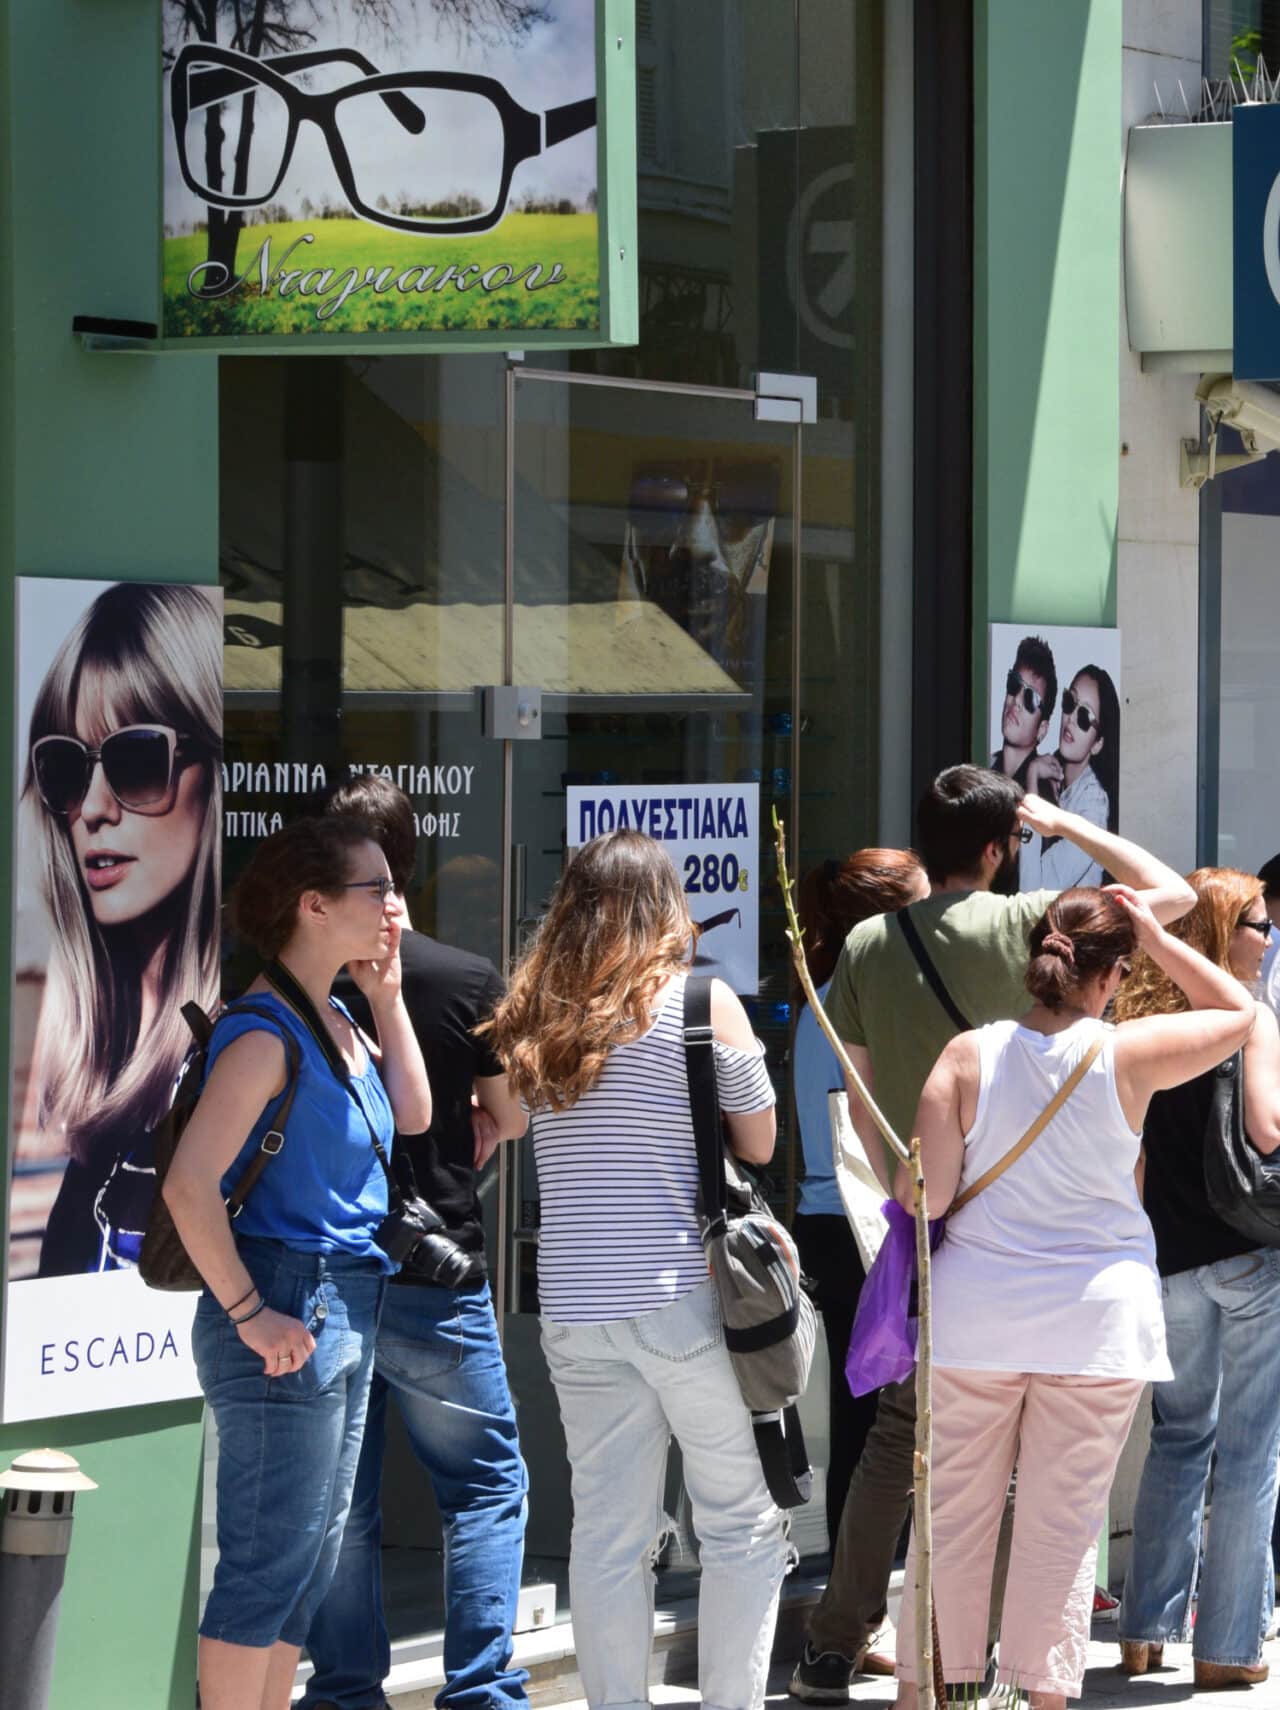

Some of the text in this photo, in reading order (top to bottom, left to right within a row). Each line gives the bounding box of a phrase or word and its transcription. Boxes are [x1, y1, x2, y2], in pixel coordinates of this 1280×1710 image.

[221, 762, 327, 793] ΑΡΙΑΝΝΑ
[225, 811, 283, 837] ΠΤΙΚΑ
[580, 797, 748, 843] ΠΟΛΥΕΣΤΙΑΚΑ
[41, 1329, 179, 1375] ESCADA
